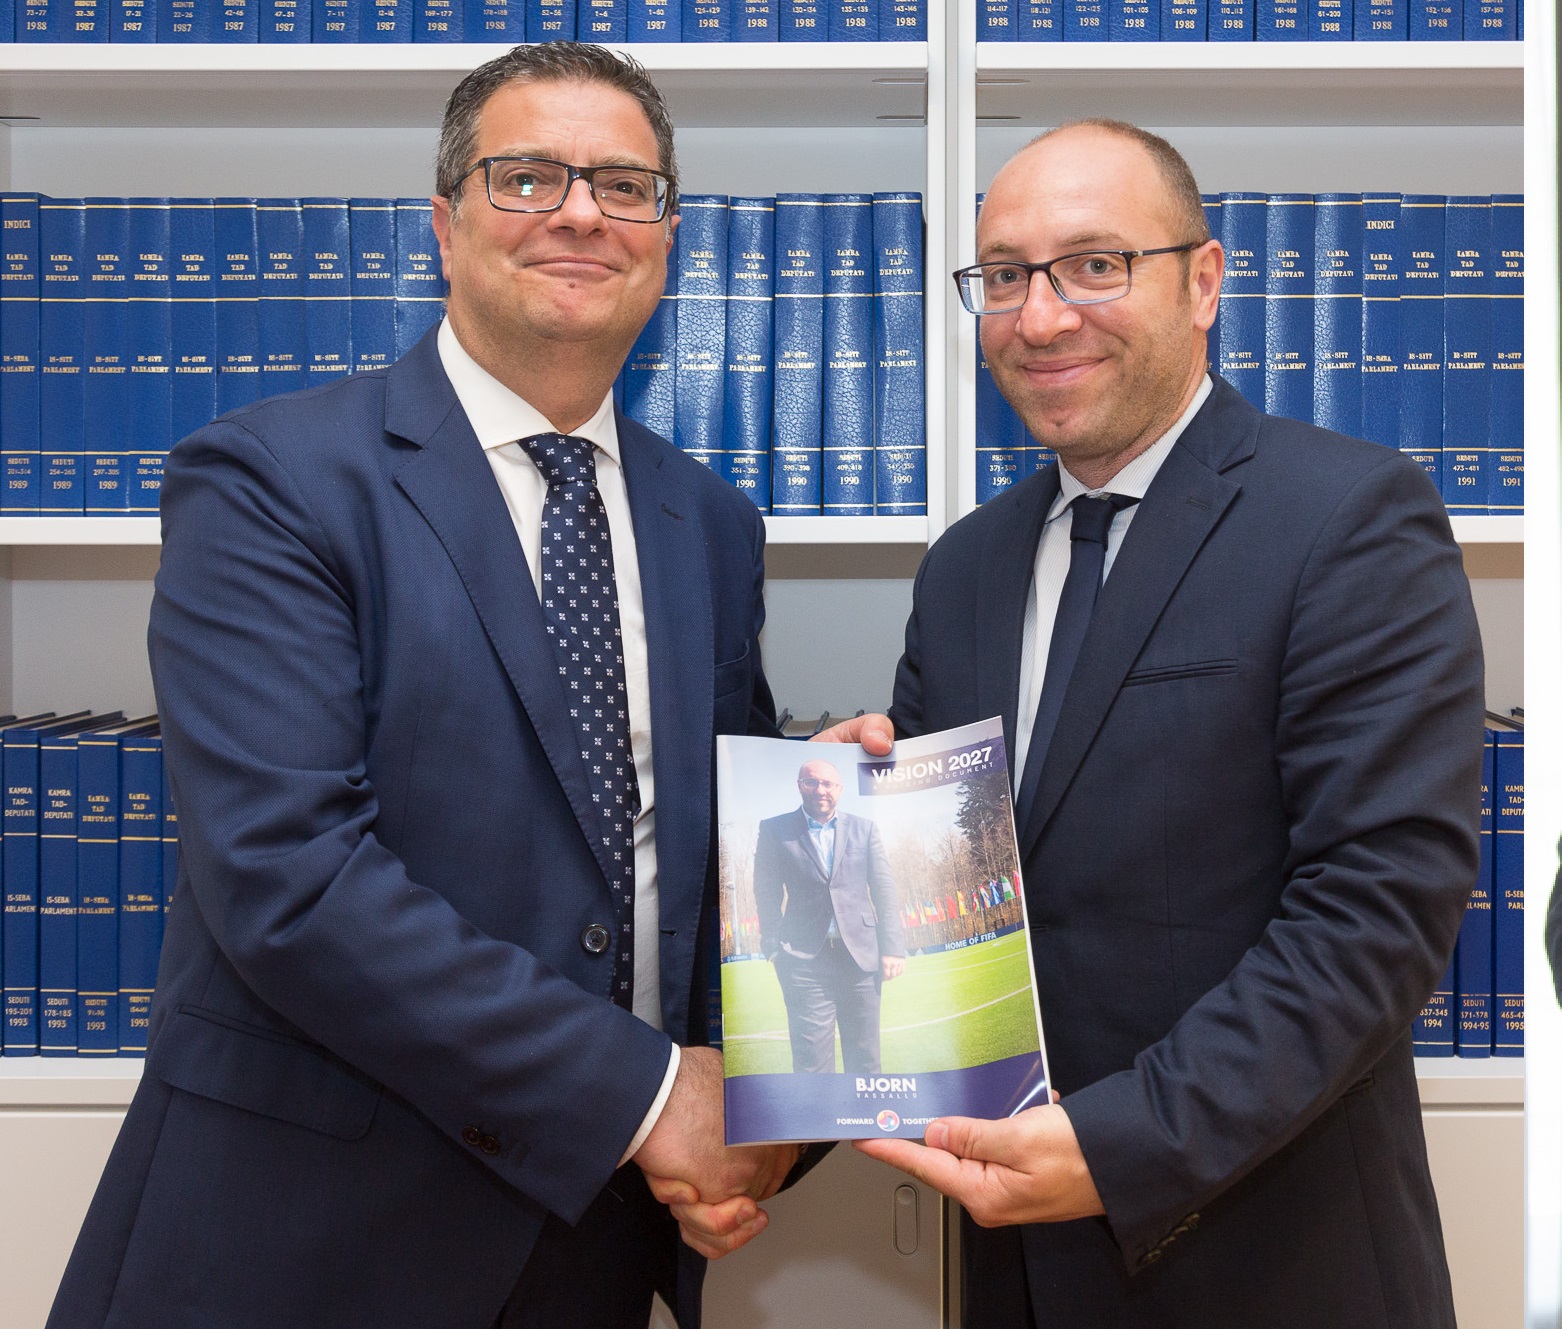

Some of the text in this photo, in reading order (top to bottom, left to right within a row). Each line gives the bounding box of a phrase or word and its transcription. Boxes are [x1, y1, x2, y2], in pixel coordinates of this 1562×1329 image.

[26, 22, 47, 30] 1988
[224, 22, 244, 30] 1987
[485, 21, 506, 30] 1988
[542, 21, 562, 30] 1987
[646, 21, 666, 30] 1987
[699, 19, 719, 28] 1988
[747, 19, 768, 28] 1988
[795, 19, 816, 28] 1988
[845, 18, 866, 27] 1988
[896, 17, 917, 26] 1988
[988, 17, 1009, 26] 1988
[1032, 19, 1053, 28] 1988
[1079, 17, 1100, 26] 1988
[1124, 19, 1145, 28] 1988
[1174, 20, 1195, 29] 1988
[1223, 20, 1244, 29] 1988
[1275, 19, 1296, 28] 1988
[1372, 21, 1393, 30] 1988
[1428, 19, 1448, 28] 1988
[1482, 19, 1503, 28] 1988
[76, 22, 95, 31] 1987
[123, 22, 142, 31] 1987
[173, 23, 192, 32] 1987
[275, 23, 295, 32] 1987
[326, 22, 345, 31] 1987
[376, 22, 396, 31] 1987
[427, 22, 448, 31] 1988
[592, 22, 611, 31] 1987
[1320, 22, 1340, 31] 1988
[3, 220, 31, 229] INDICI
[1366, 220, 1395, 230] INDICI
[1365, 273, 1398, 281] DEPUTATI
[1450, 270, 1483, 278] DEPUTATI
[735, 479, 756, 488] 1990
[787, 476, 807, 486] 1990
[840, 476, 860, 485] 1990
[892, 475, 913, 484] 1990
[992, 477, 1013, 486] 1990
[1457, 477, 1476, 486] 1991
[1503, 478, 1521, 487] 1991
[8, 480, 28, 489] 1989
[52, 481, 72, 490] 1989
[99, 481, 118, 489] 1989
[141, 480, 161, 489] 1989
[872, 746, 993, 784] VISION 2027
[937, 761, 994, 781] DOCUMENT
[8, 787, 33, 795] KAMRA
[48, 789, 71, 797] KAMRA
[1505, 785, 1524, 793] KAMR
[4, 809, 35, 817] DEPUTATI
[7, 894, 31, 902] IS-SEBA
[46, 896, 70, 904] IS-SEBA
[40, 907, 77, 915] PARLAMENT
[945, 931, 997, 950] HOME OF FIFA
[7, 996, 30, 1004] SEDUTI
[46, 998, 69, 1006] SEDUTI
[1463, 999, 1485, 1007] SEDUTI
[9, 1018, 28, 1027] 1993
[47, 1020, 67, 1028] 1993
[86, 1022, 106, 1031] 1993
[130, 1018, 149, 1027] 1993
[1423, 1019, 1443, 1028] 1994
[1505, 1022, 1524, 1030] 1995
[855, 1077, 917, 1092] BJORN
[902, 1117, 938, 1125] TOGETH
